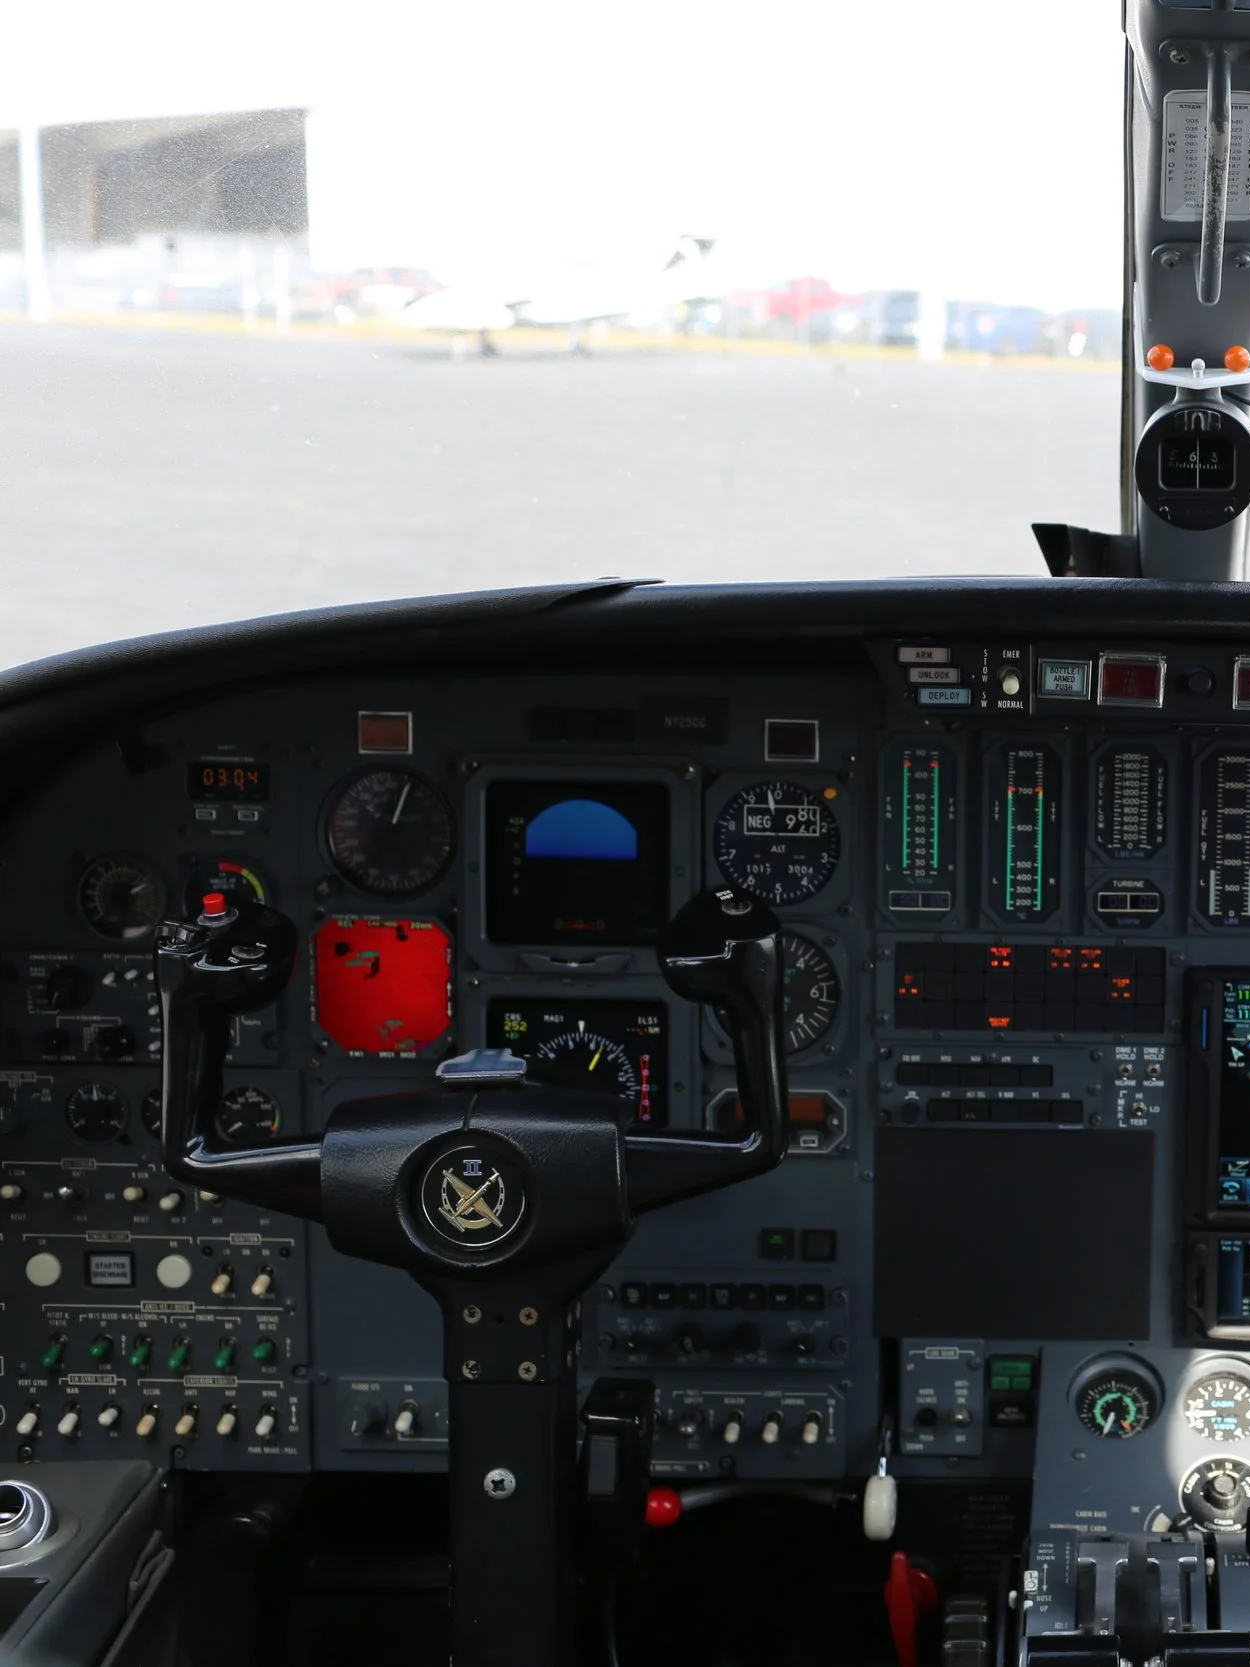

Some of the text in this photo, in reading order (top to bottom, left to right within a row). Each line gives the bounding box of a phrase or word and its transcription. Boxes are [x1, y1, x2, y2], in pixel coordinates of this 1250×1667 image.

[1189, 452, 1218, 462] 6 3
[1002, 650, 1020, 658] EMER
[918, 670, 950, 679] UNLOCK
[1050, 666, 1076, 676] BOTTLE
[1053, 675, 1075, 683] ARMED
[1055, 683, 1073, 692] PUSH
[928, 692, 960, 700] DEPLOY
[998, 700, 1023, 709] NORMAL
[774, 790, 782, 799] 0
[728, 820, 736, 832] 8
[748, 816, 772, 829] NEG
[821, 822, 828, 832] 2
[770, 845, 786, 853] ALT
[728, 849, 736, 860] 7
[821, 853, 828, 863] 3
[748, 875, 755, 885] 6
[801, 876, 808, 886] 4
[775, 883, 782, 894] 5
[796, 958, 805, 969] 4
[810, 987, 820, 998] 6
[504, 1013, 521, 1021] CRS
[796, 1013, 804, 1024] 4
[504, 1021, 527, 1030] 252
[463, 1160, 482, 1176] II
